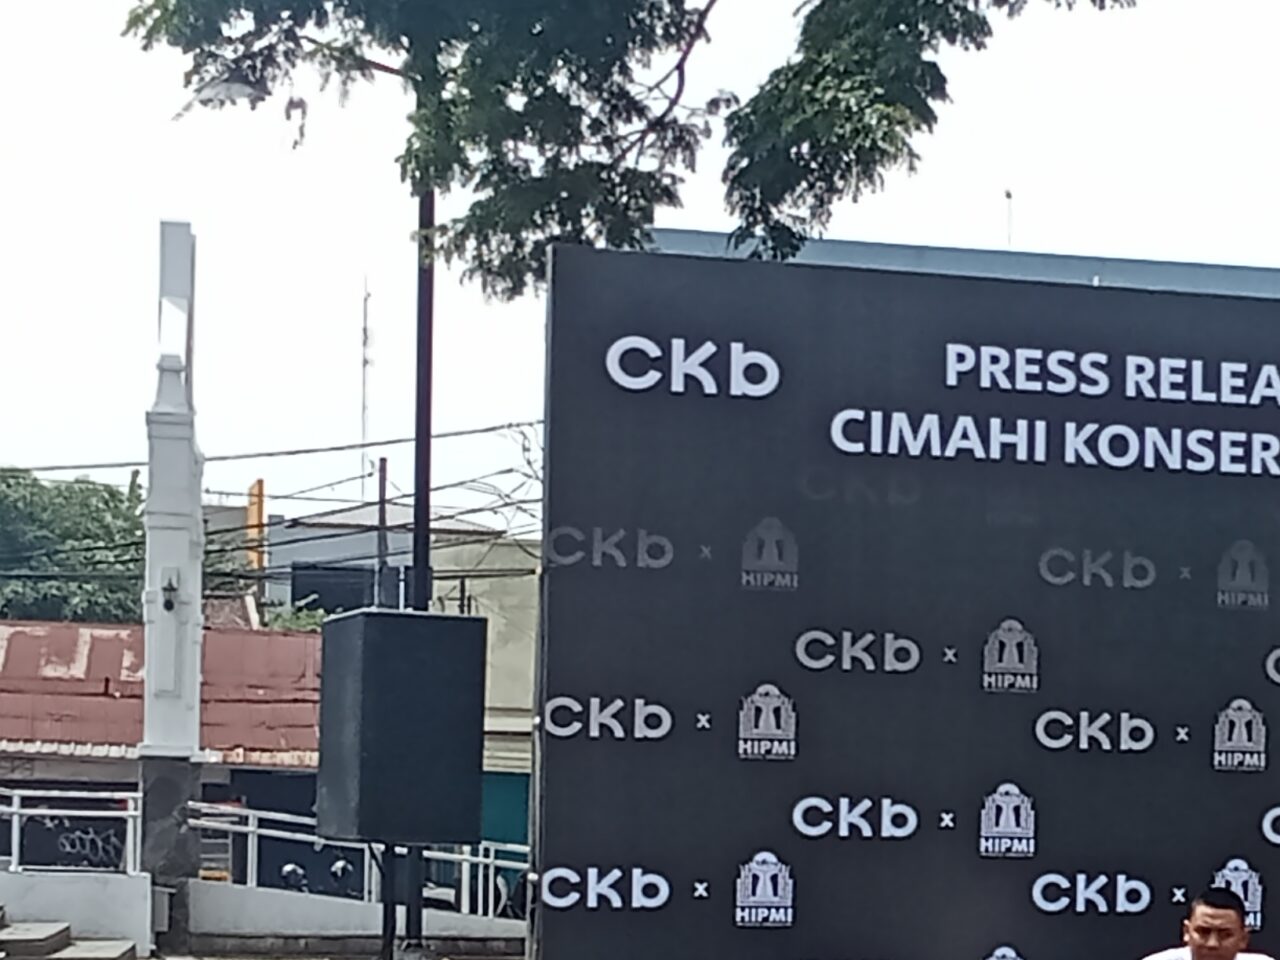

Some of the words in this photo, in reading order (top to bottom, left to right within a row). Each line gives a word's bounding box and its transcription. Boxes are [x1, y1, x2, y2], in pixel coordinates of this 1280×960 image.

[605, 335, 780, 397] CKb
[946, 343, 1110, 395] PRESS
[830, 408, 1047, 462] CIMAHI
[741, 570, 799, 588] HIPMI
[1217, 590, 1269, 605] HIPMI
[795, 630, 920, 672] CKb
[982, 672, 1038, 690] HIPMI
[544, 696, 672, 739] CKb
[739, 737, 795, 756] HIPMI
[1035, 710, 1154, 751] CKb
[1214, 750, 1265, 768] HIPMI
[792, 796, 918, 838] CKb
[980, 836, 1034, 854] HIPMI
[541, 867, 670, 908] CKb
[736, 908, 792, 924] HIPMI
[1031, 873, 1151, 913] CKb
